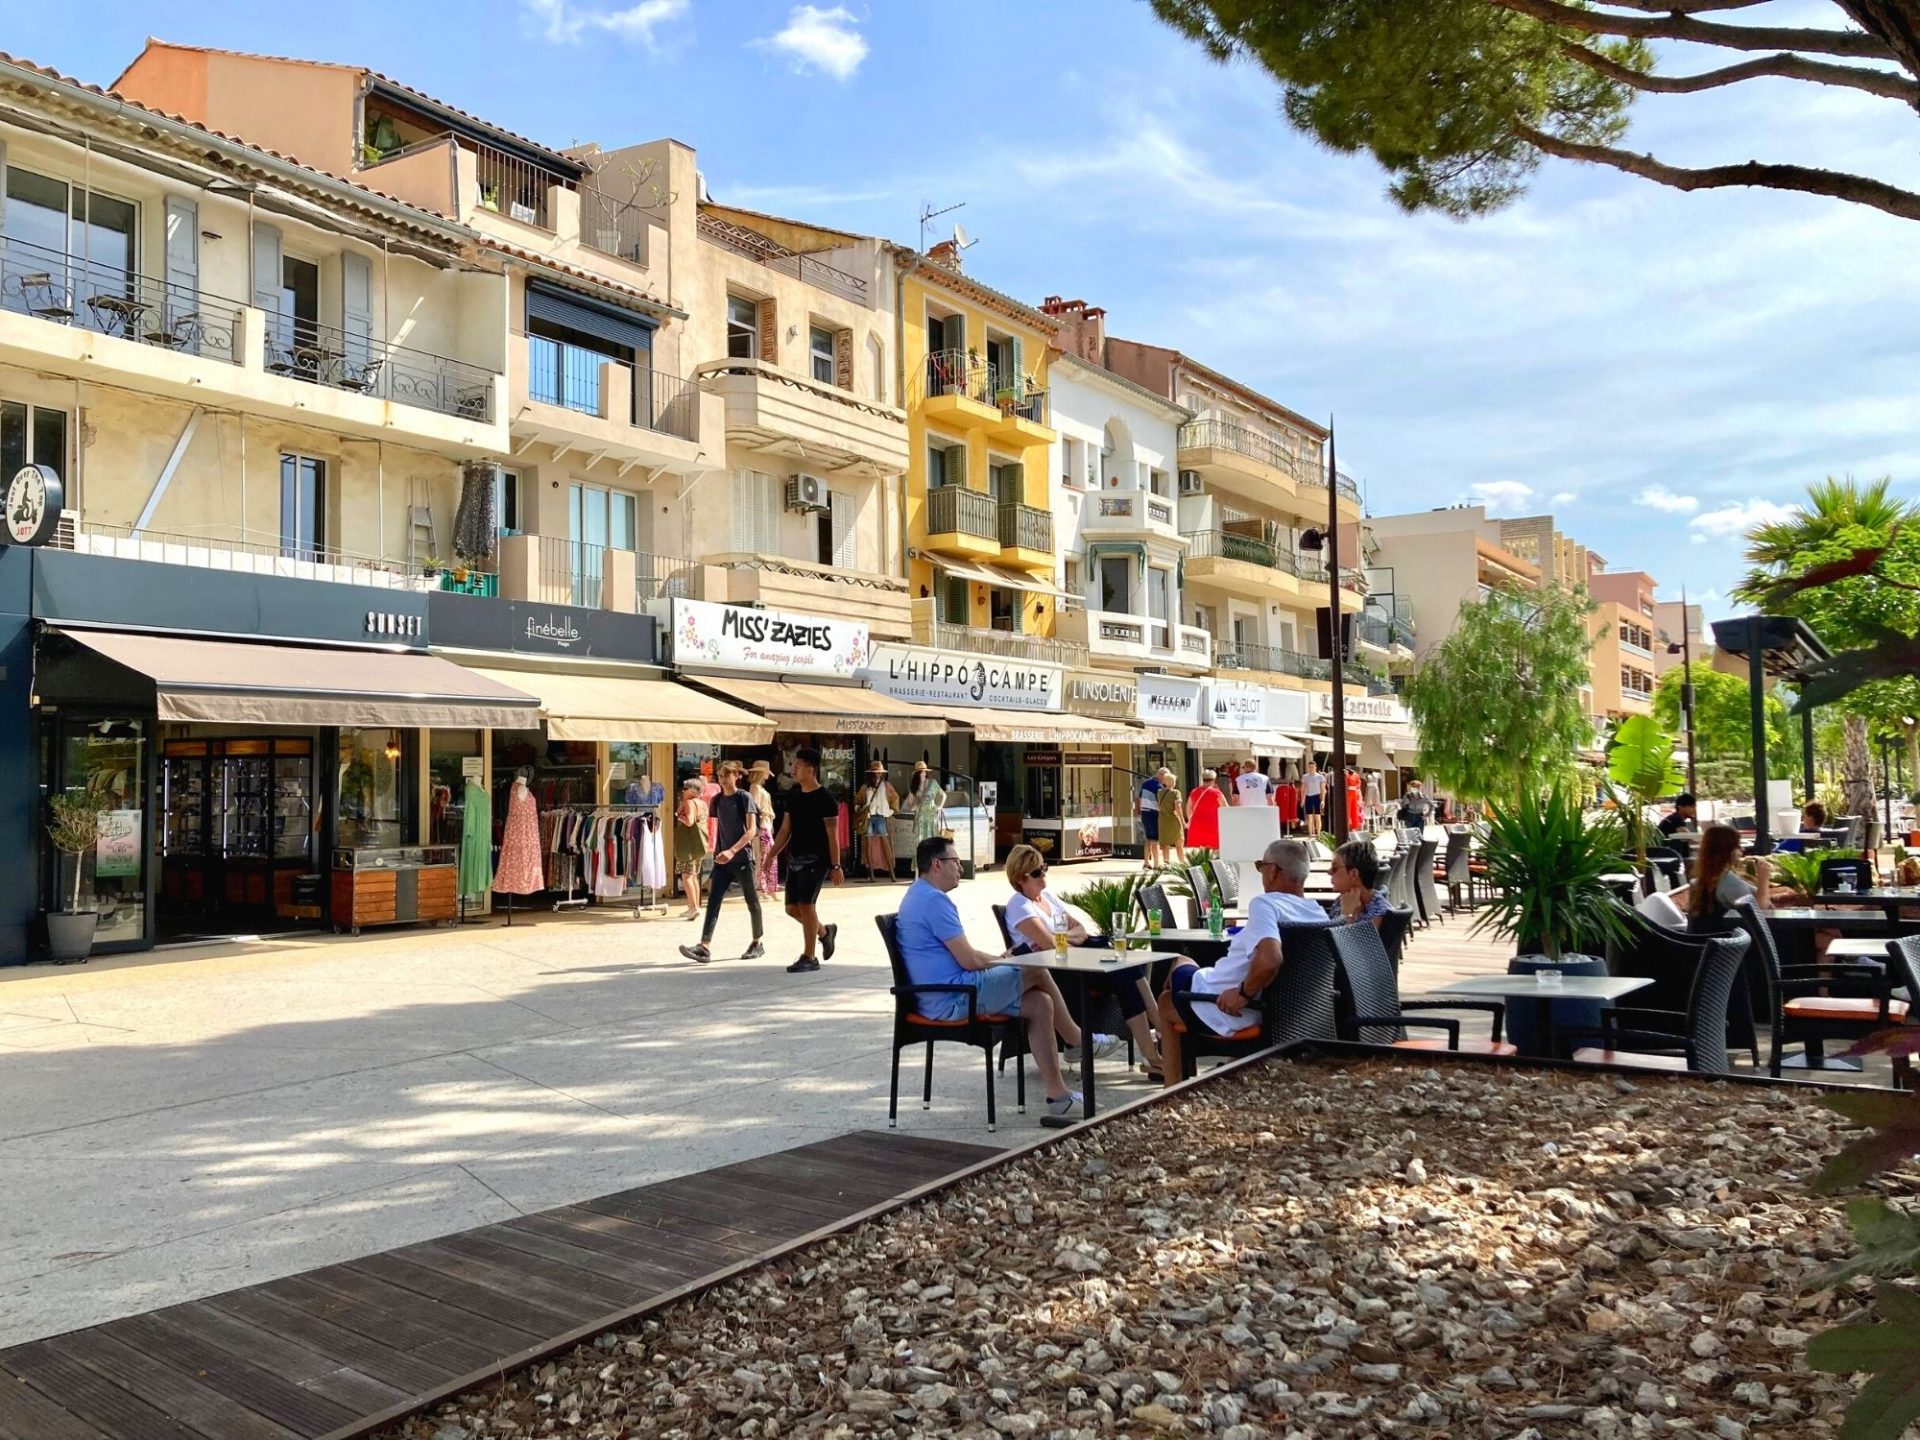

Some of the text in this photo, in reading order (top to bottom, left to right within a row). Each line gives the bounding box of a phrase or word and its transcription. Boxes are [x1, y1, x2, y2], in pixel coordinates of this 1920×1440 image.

[16, 526, 32, 536] JOTT
[367, 611, 422, 636] SUNSET
[525, 610, 579, 638] finébelle
[743, 646, 758, 660] For
[759, 652, 790, 666] amazing
[989, 669, 1048, 692] CAMPE
[1072, 680, 1136, 704] L'INSOLENTE
[1151, 694, 1191, 708] WEEKEND
[1229, 696, 1261, 713] HUBLOT
[1011, 729, 1044, 740] BRASSERIE
[1075, 848, 1085, 856] Les
